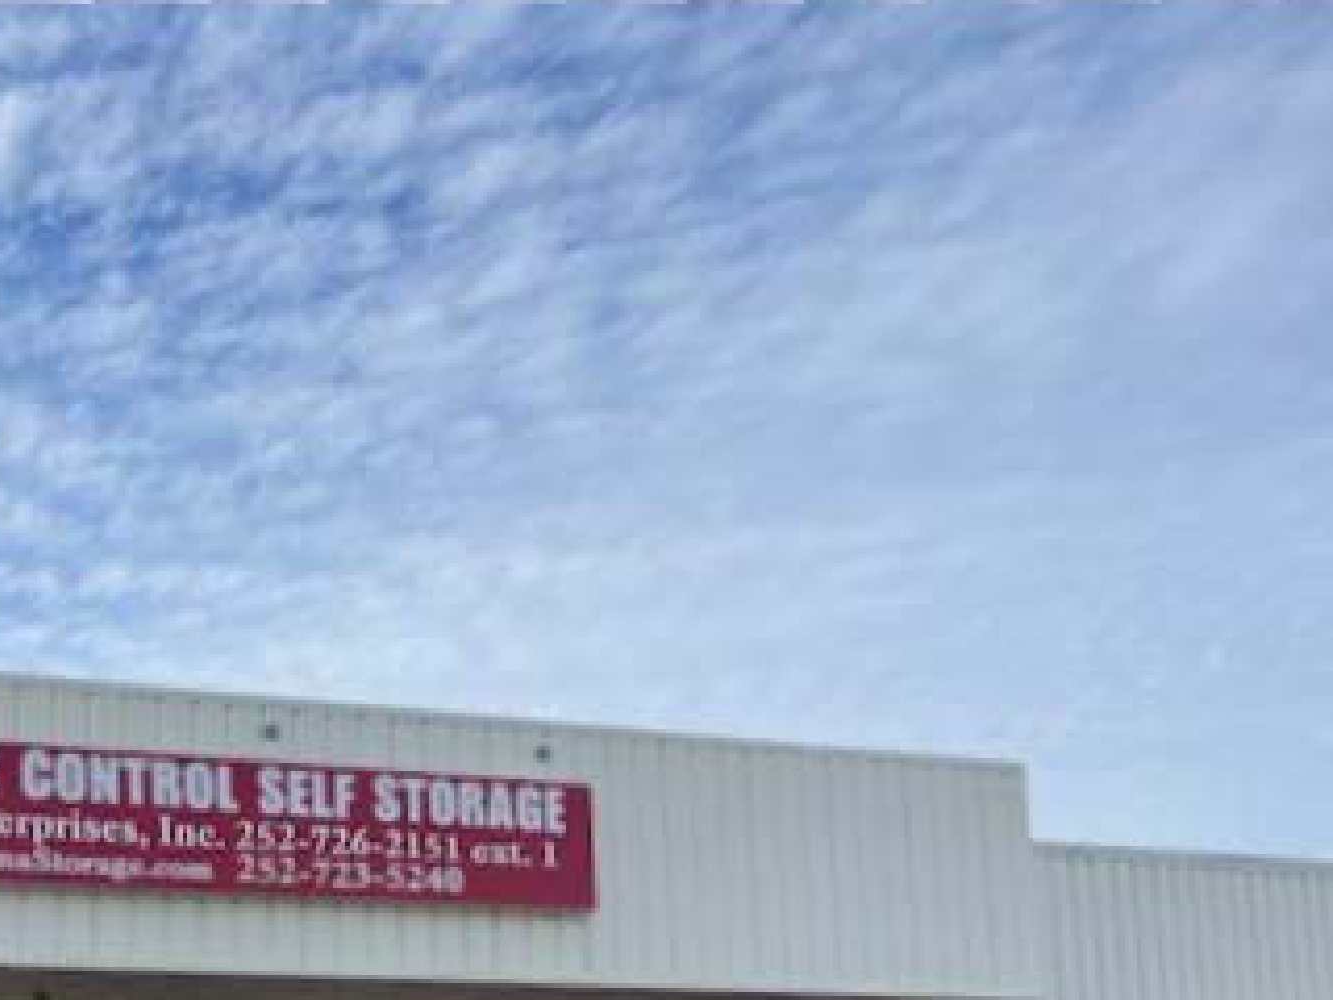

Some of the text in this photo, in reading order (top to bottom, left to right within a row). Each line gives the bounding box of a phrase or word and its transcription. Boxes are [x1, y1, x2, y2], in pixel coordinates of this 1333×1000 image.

[19, 750, 237, 811] CONTROL
[258, 768, 355, 819] SELF
[374, 775, 566, 833] STORAGE
[160, 813, 225, 850] Inc.
